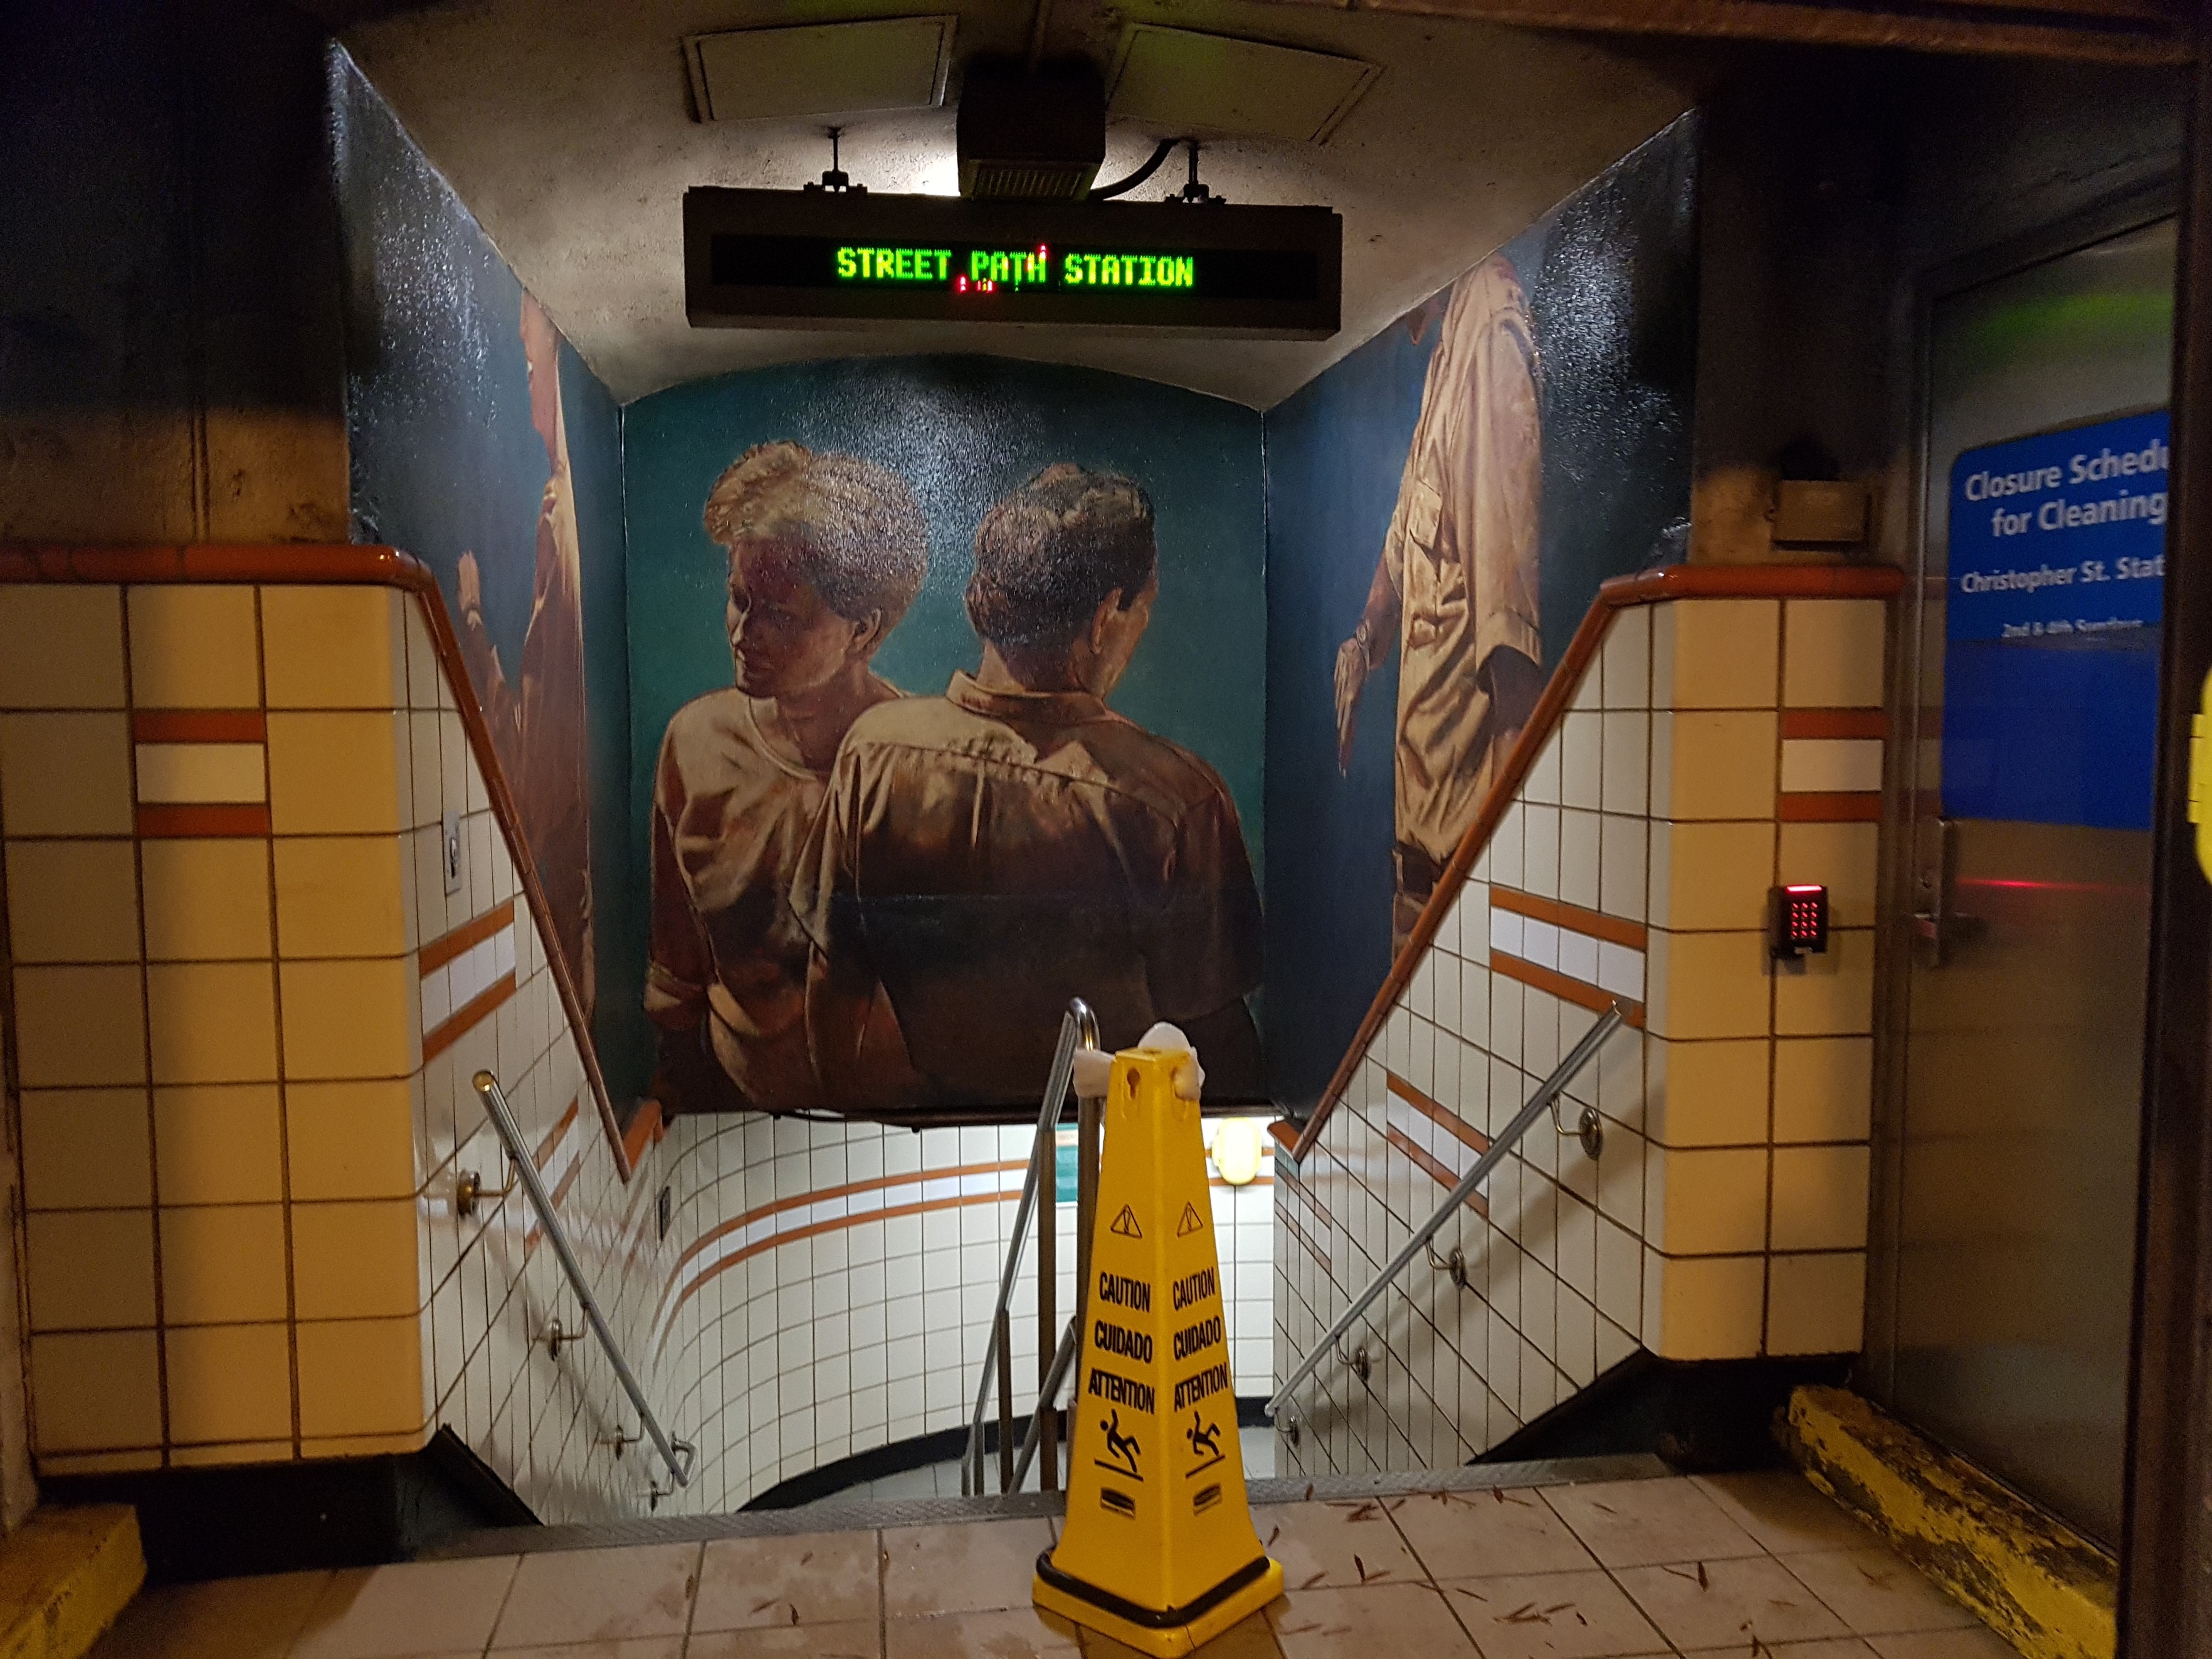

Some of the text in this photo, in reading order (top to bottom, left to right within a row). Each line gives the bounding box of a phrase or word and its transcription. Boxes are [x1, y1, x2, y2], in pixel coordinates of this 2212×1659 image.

[837, 247, 1193, 287] STREET PATH STATION
[1965, 465, 2063, 501] Closure
[1991, 489, 2167, 537] for Cleaning
[1961, 564, 2077, 593] Christopher
[1099, 1272, 1151, 1313] CAUTION
[1172, 1267, 1216, 1312] CAUTION
[1094, 1320, 1153, 1364] CUIDADO
[1173, 1315, 1221, 1361] CUIDADO
[1088, 1367, 1155, 1414] ATTENTION
[1174, 1362, 1228, 1412] ATTENTION
